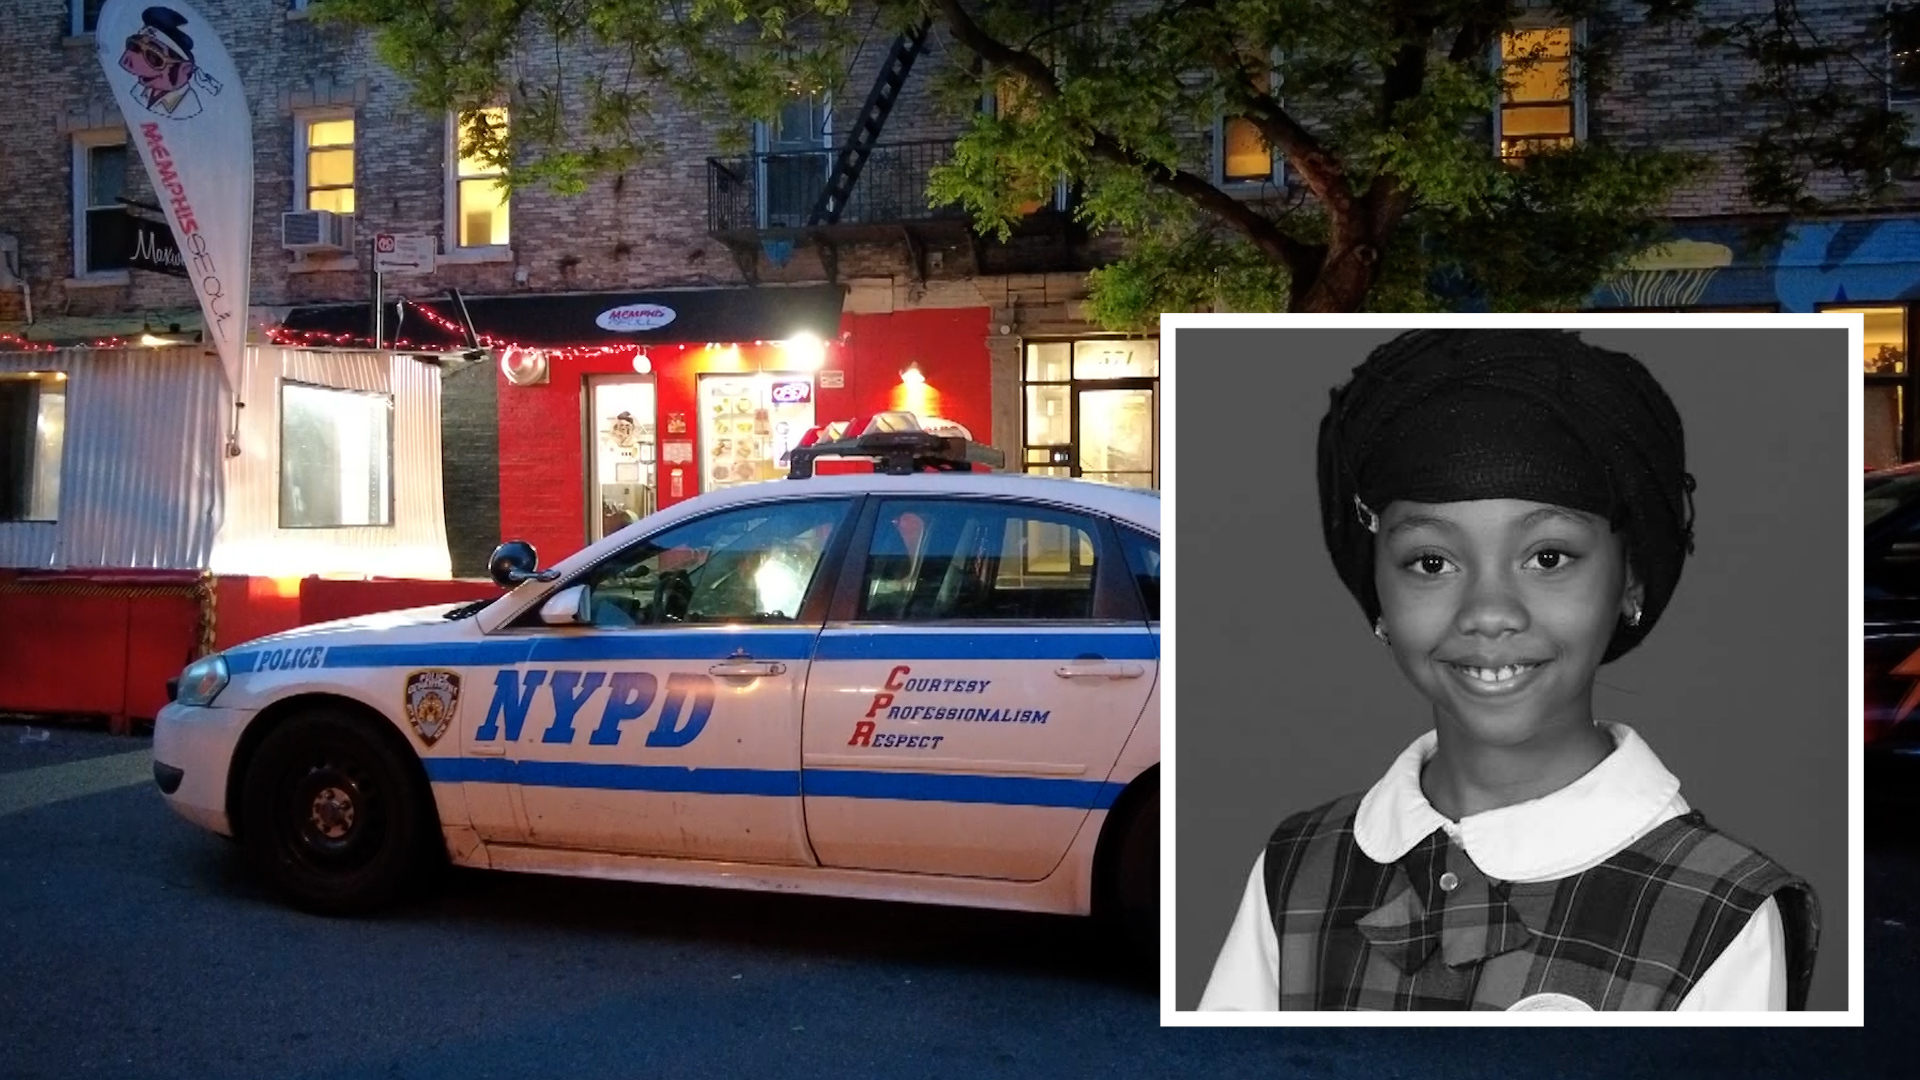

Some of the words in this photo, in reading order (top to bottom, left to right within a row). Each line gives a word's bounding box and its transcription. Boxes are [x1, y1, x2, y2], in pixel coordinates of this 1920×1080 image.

[129, 228, 185, 266] Maxw
[258, 646, 324, 671] POLICE
[884, 665, 991, 694] COURTESY
[475, 669, 717, 748] NYPD
[865, 693, 1051, 724] PROFESSIONALISM
[847, 721, 945, 750] RESPECT
